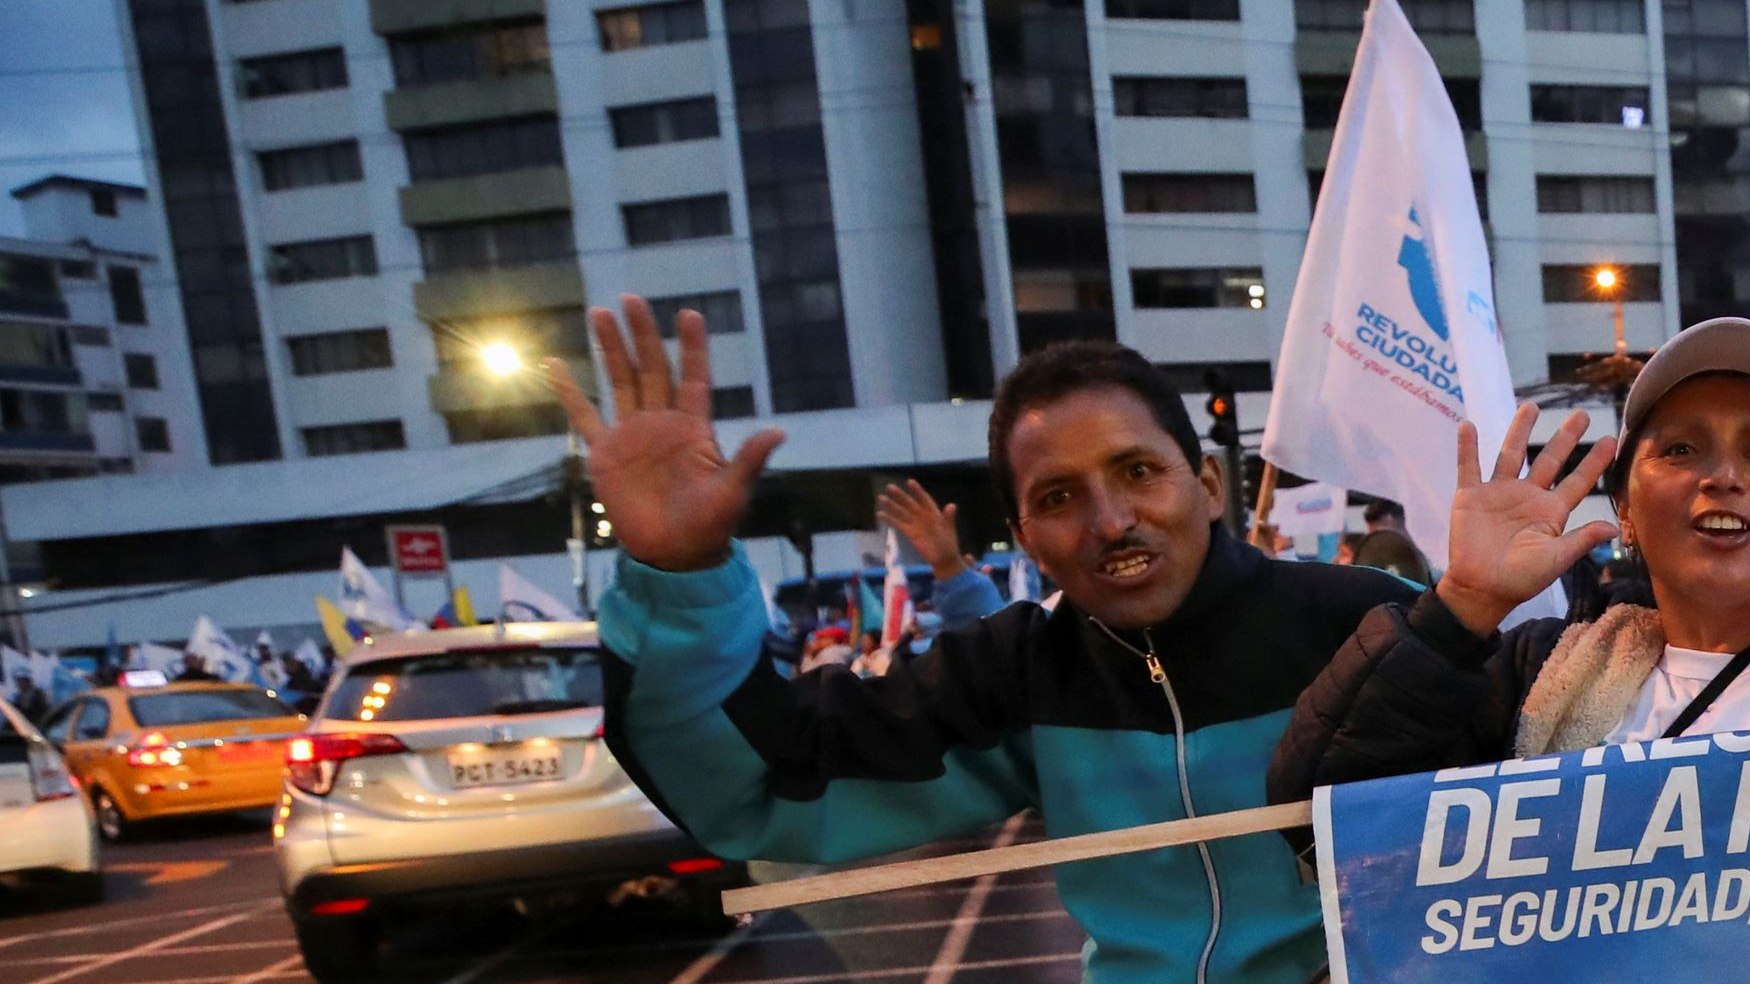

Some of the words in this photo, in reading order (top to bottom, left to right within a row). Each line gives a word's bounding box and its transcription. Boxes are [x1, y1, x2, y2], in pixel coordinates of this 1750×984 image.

[1356, 325, 1465, 403] CIUDADA
[1415, 777, 1562, 887] DE
[1571, 765, 1704, 874] LA
